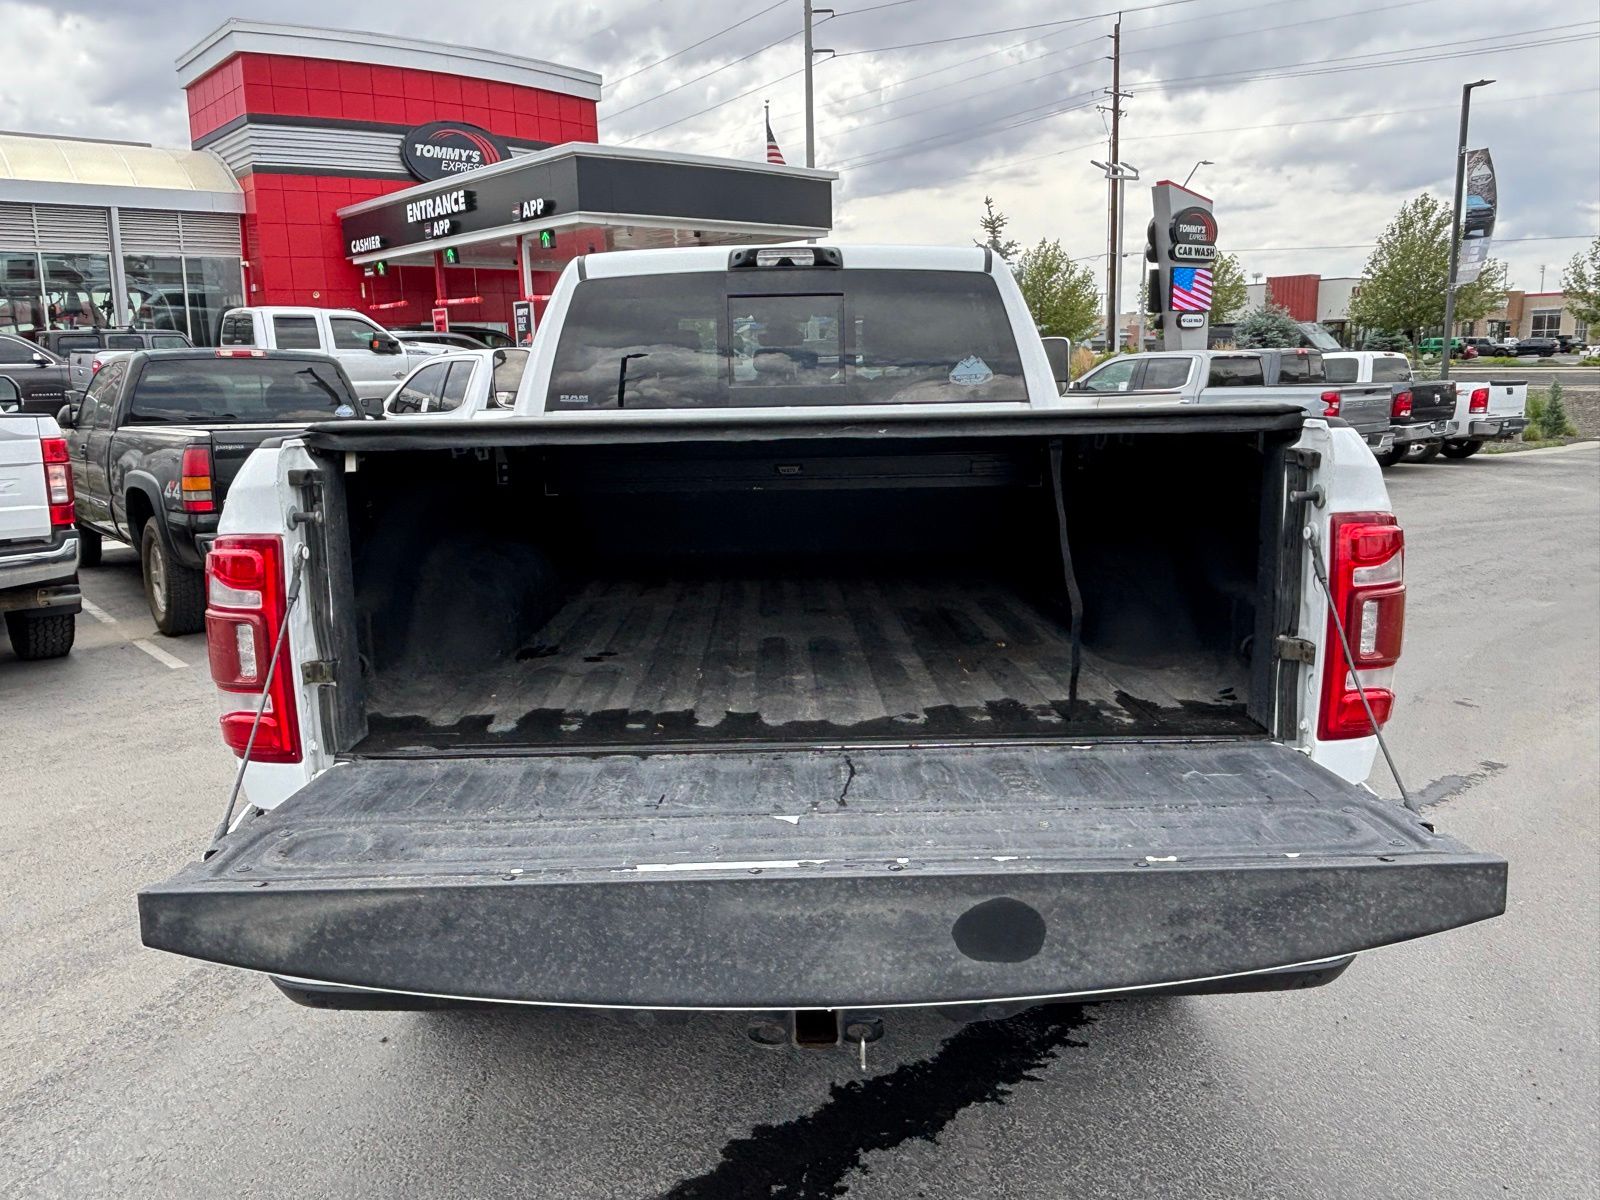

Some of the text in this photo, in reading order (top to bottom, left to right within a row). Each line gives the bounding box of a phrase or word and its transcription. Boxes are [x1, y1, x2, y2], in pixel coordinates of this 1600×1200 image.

[414, 144, 481, 163] TOMMY'S
[406, 190, 466, 223] ENTRANCE
[522, 198, 544, 218] APP
[433, 219, 450, 236] APP
[1179, 224, 1206, 234] TOMMY'S
[351, 235, 381, 253] CASHIER
[1178, 246, 1215, 257] CAR WASH
